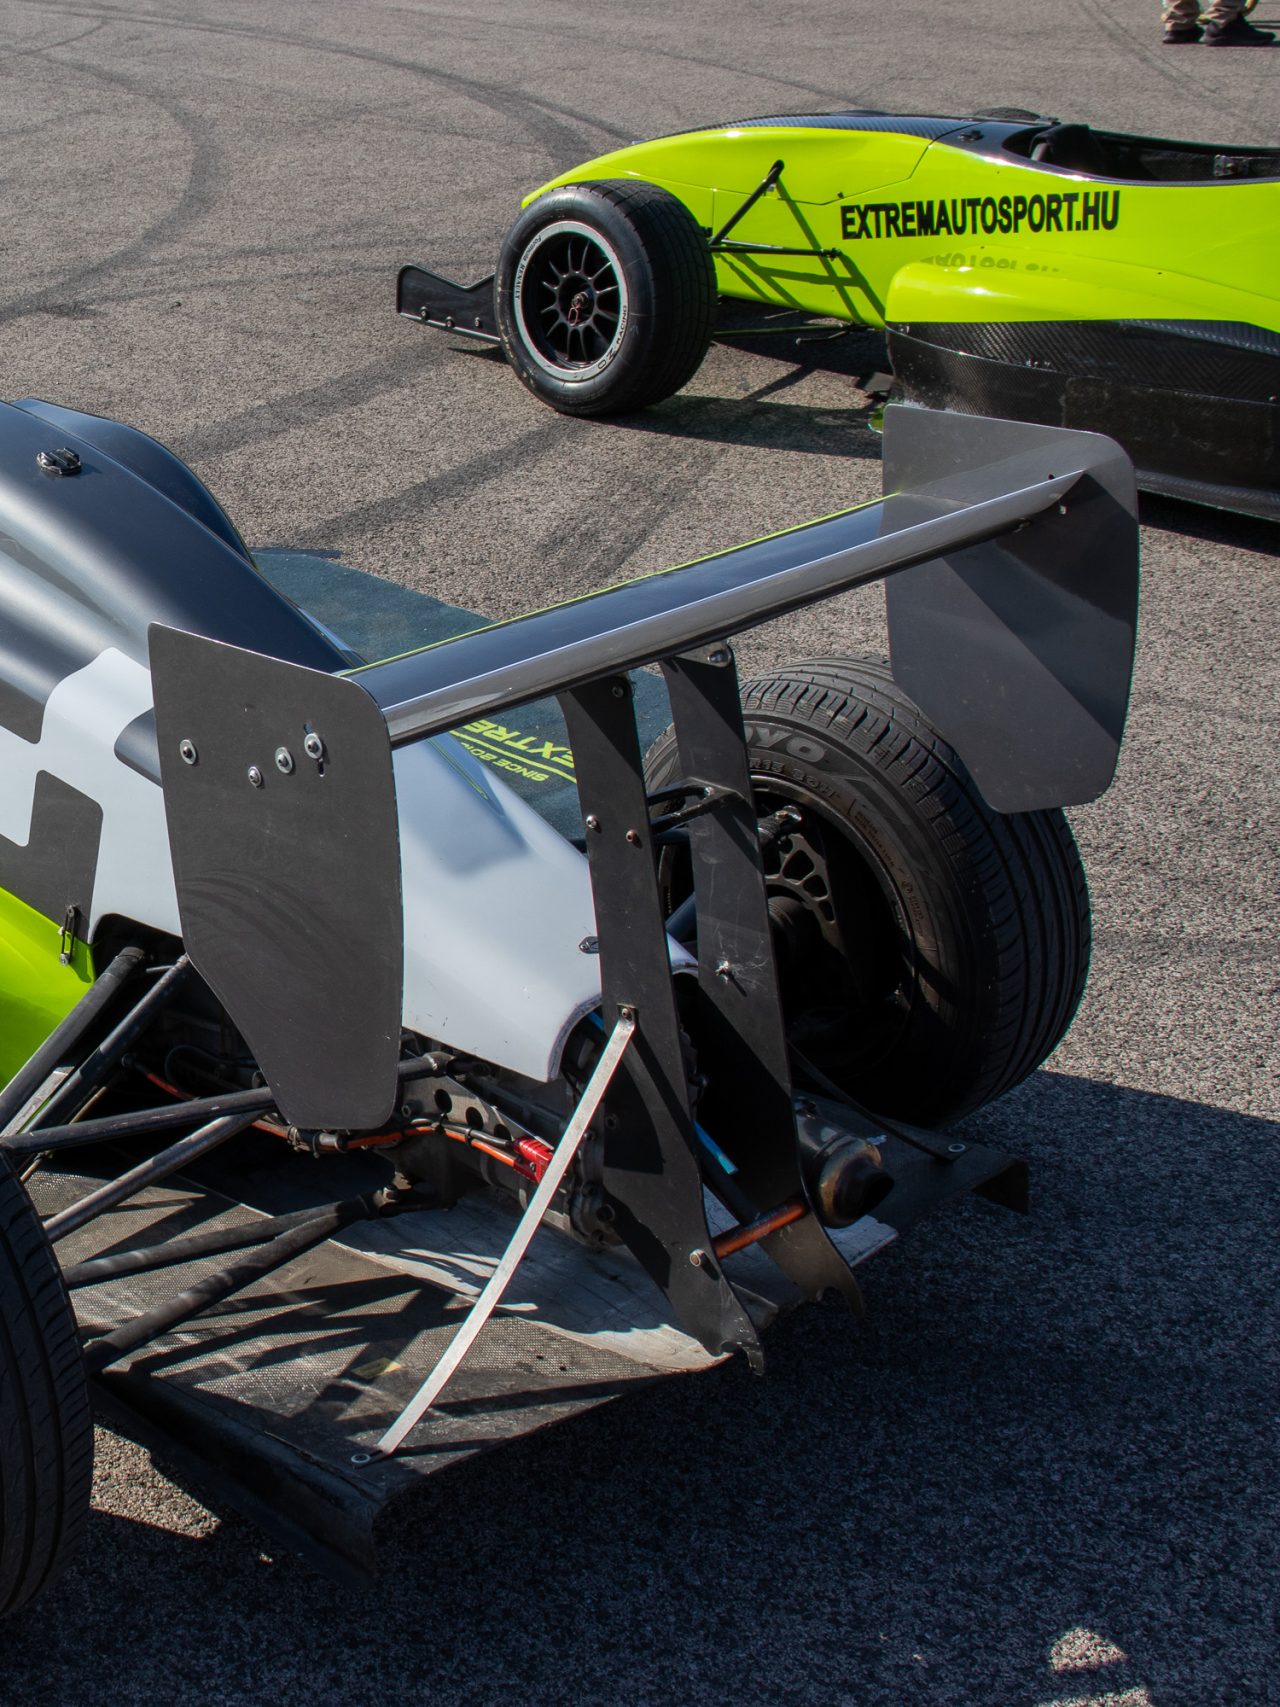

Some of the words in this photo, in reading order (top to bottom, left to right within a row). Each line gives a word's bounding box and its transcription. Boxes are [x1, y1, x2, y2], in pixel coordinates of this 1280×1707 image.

[840, 190, 1120, 240] EXTREMAUTOSPORT.HU
[616, 305, 627, 344] RACING
[744, 726, 825, 763] YO
[493, 759, 550, 782] SINCE
